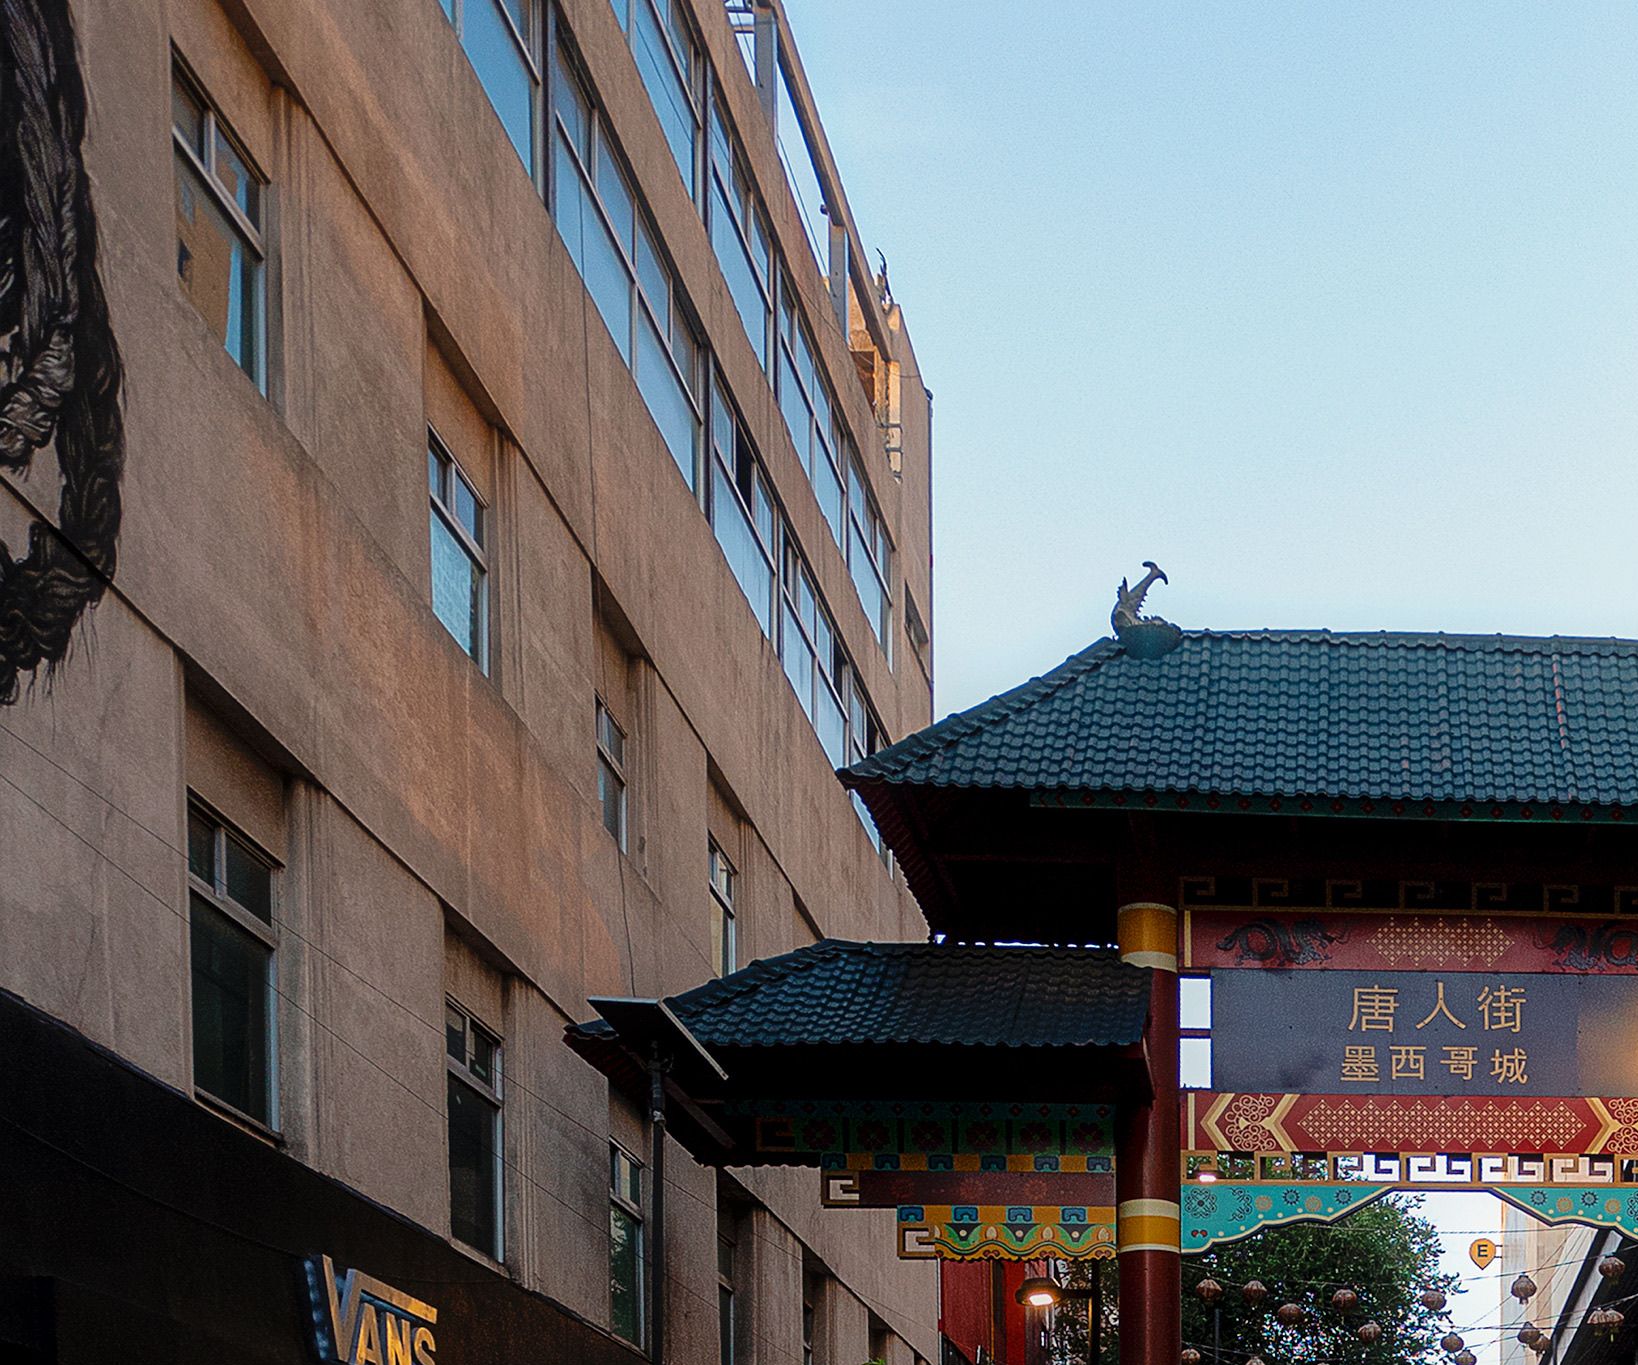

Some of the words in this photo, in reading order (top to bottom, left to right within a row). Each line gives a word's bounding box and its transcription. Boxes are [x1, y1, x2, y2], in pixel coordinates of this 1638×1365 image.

[1347, 981, 1527, 1033] 唐人街
[1340, 1045, 1529, 1084] 墨西哥城
[1478, 1244, 1488, 1257] E
